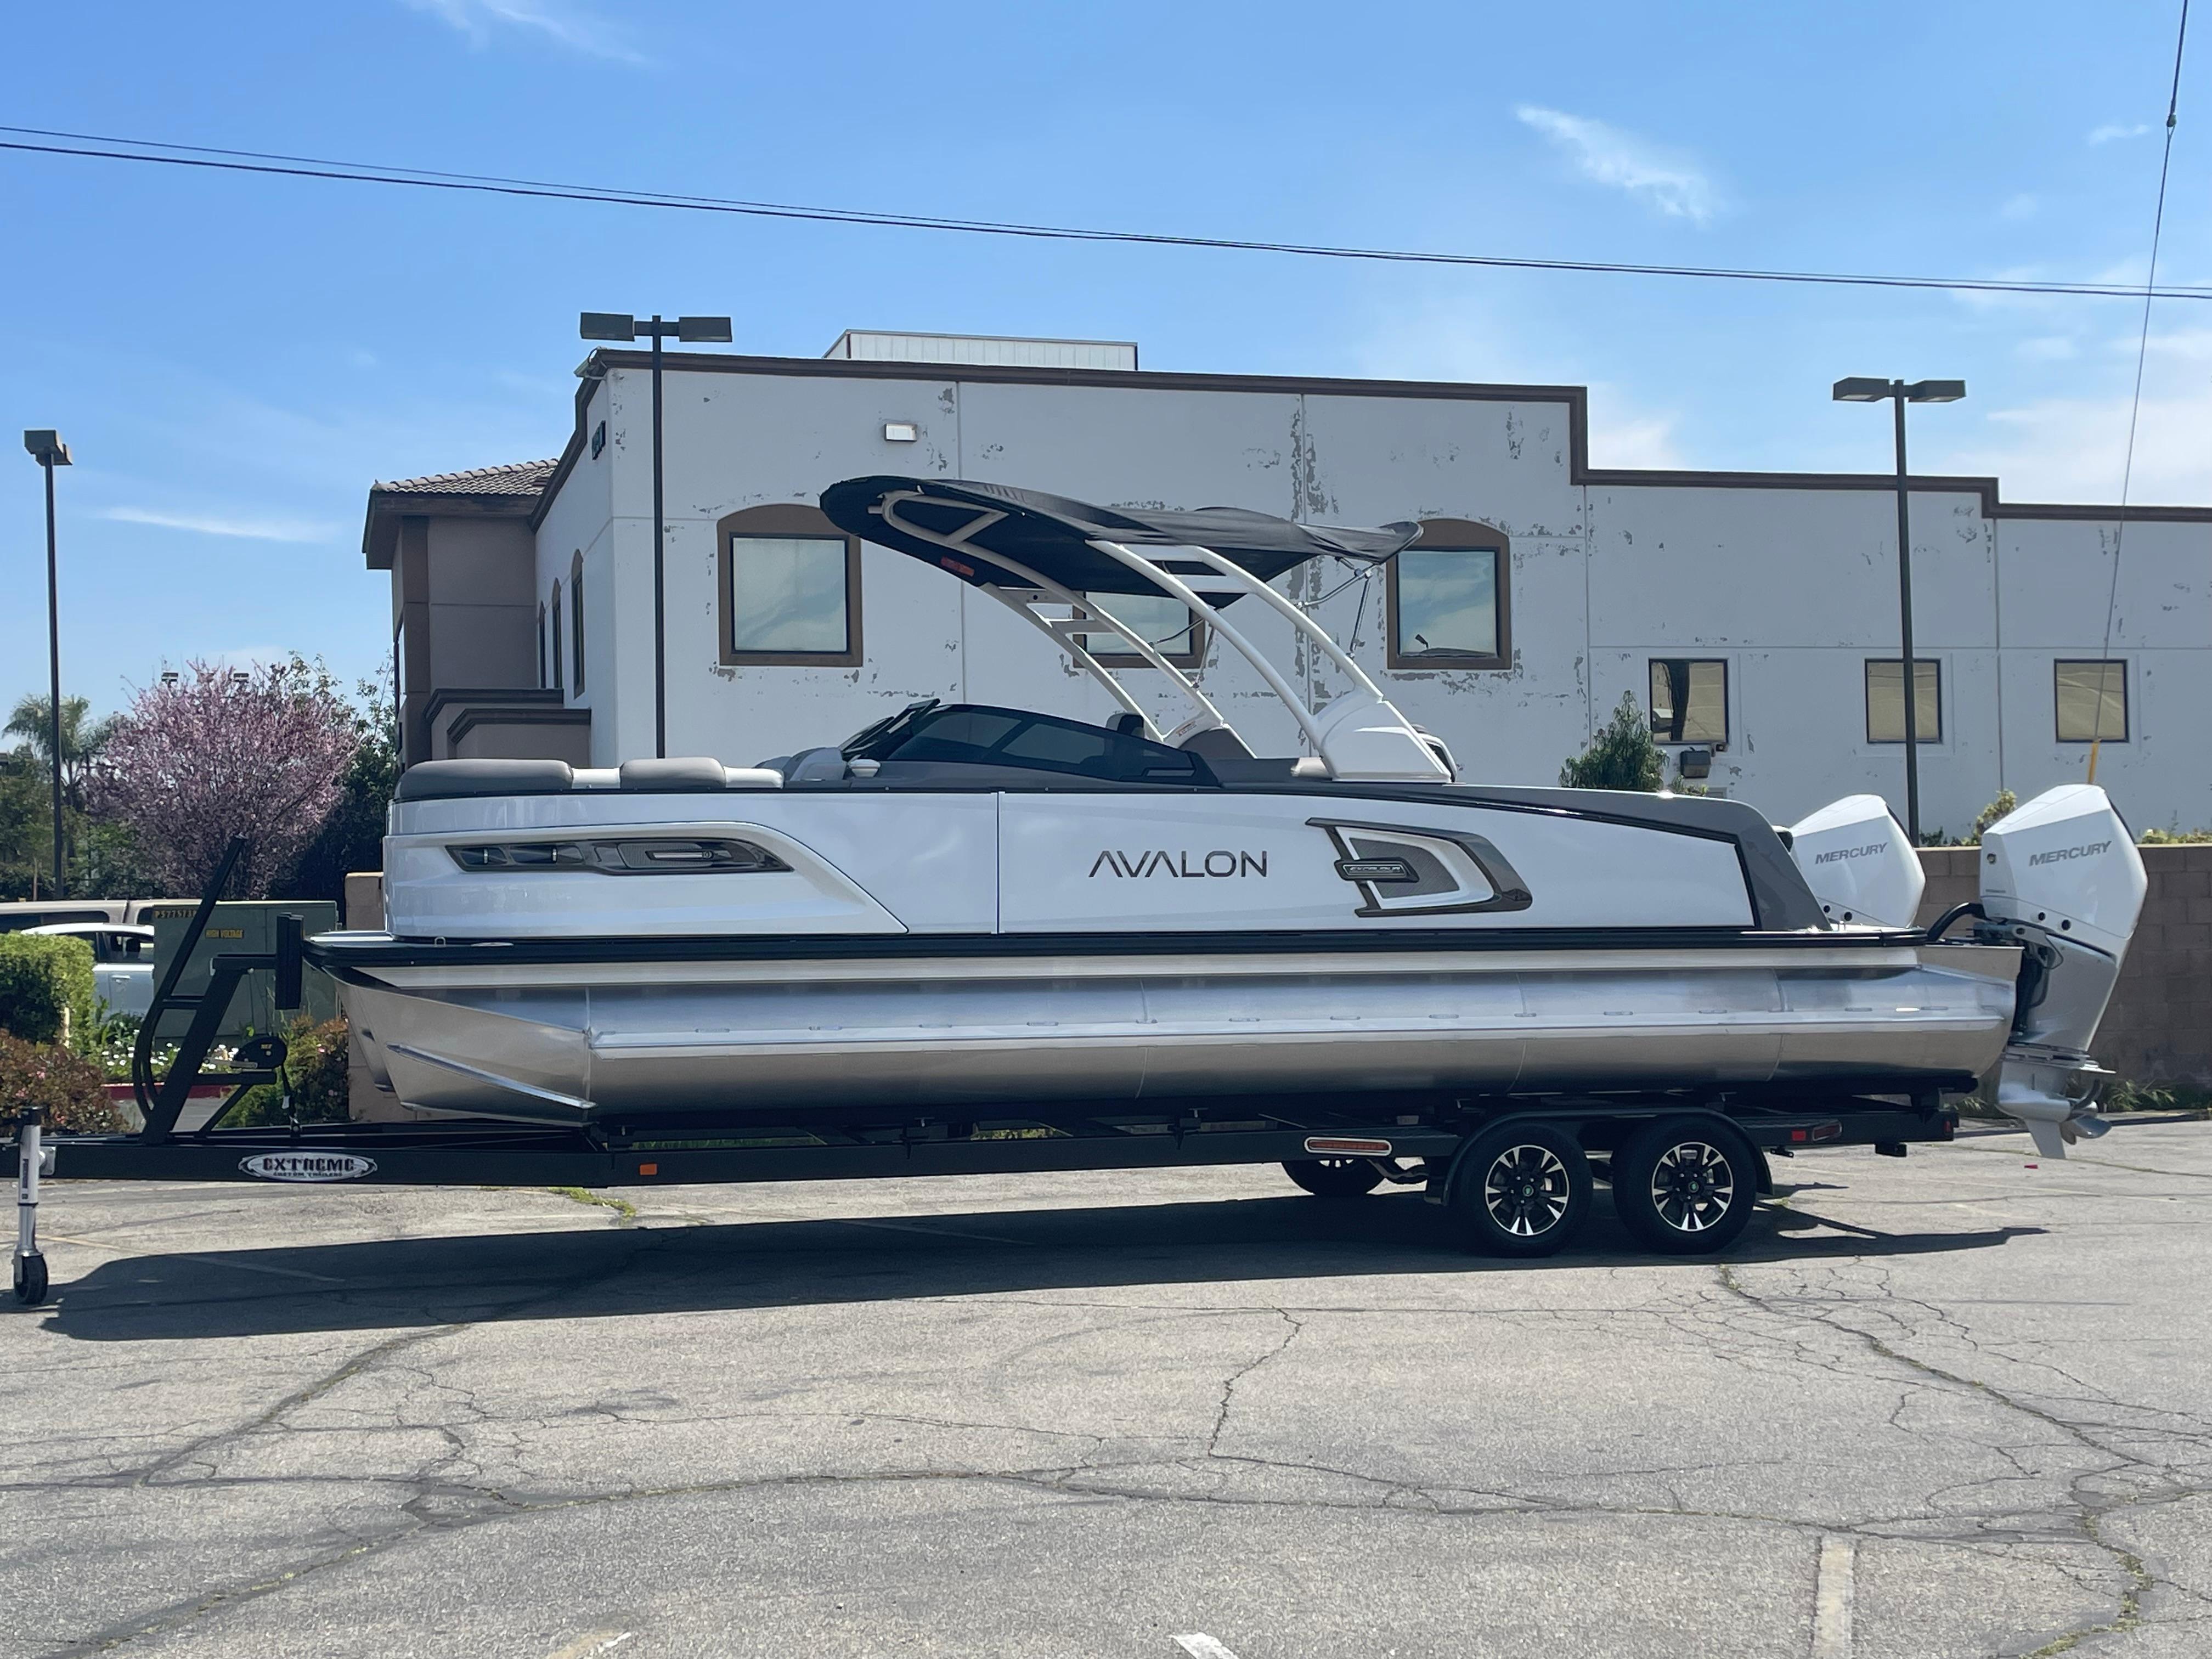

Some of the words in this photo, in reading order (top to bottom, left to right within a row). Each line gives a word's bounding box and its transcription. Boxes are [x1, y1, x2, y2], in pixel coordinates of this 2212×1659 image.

[1088, 850, 1267, 878] AVALON
[1815, 842, 1888, 864] MERCURY
[2029, 840, 2112, 866] MERCURY
[263, 1158, 354, 1171] EXTREME
